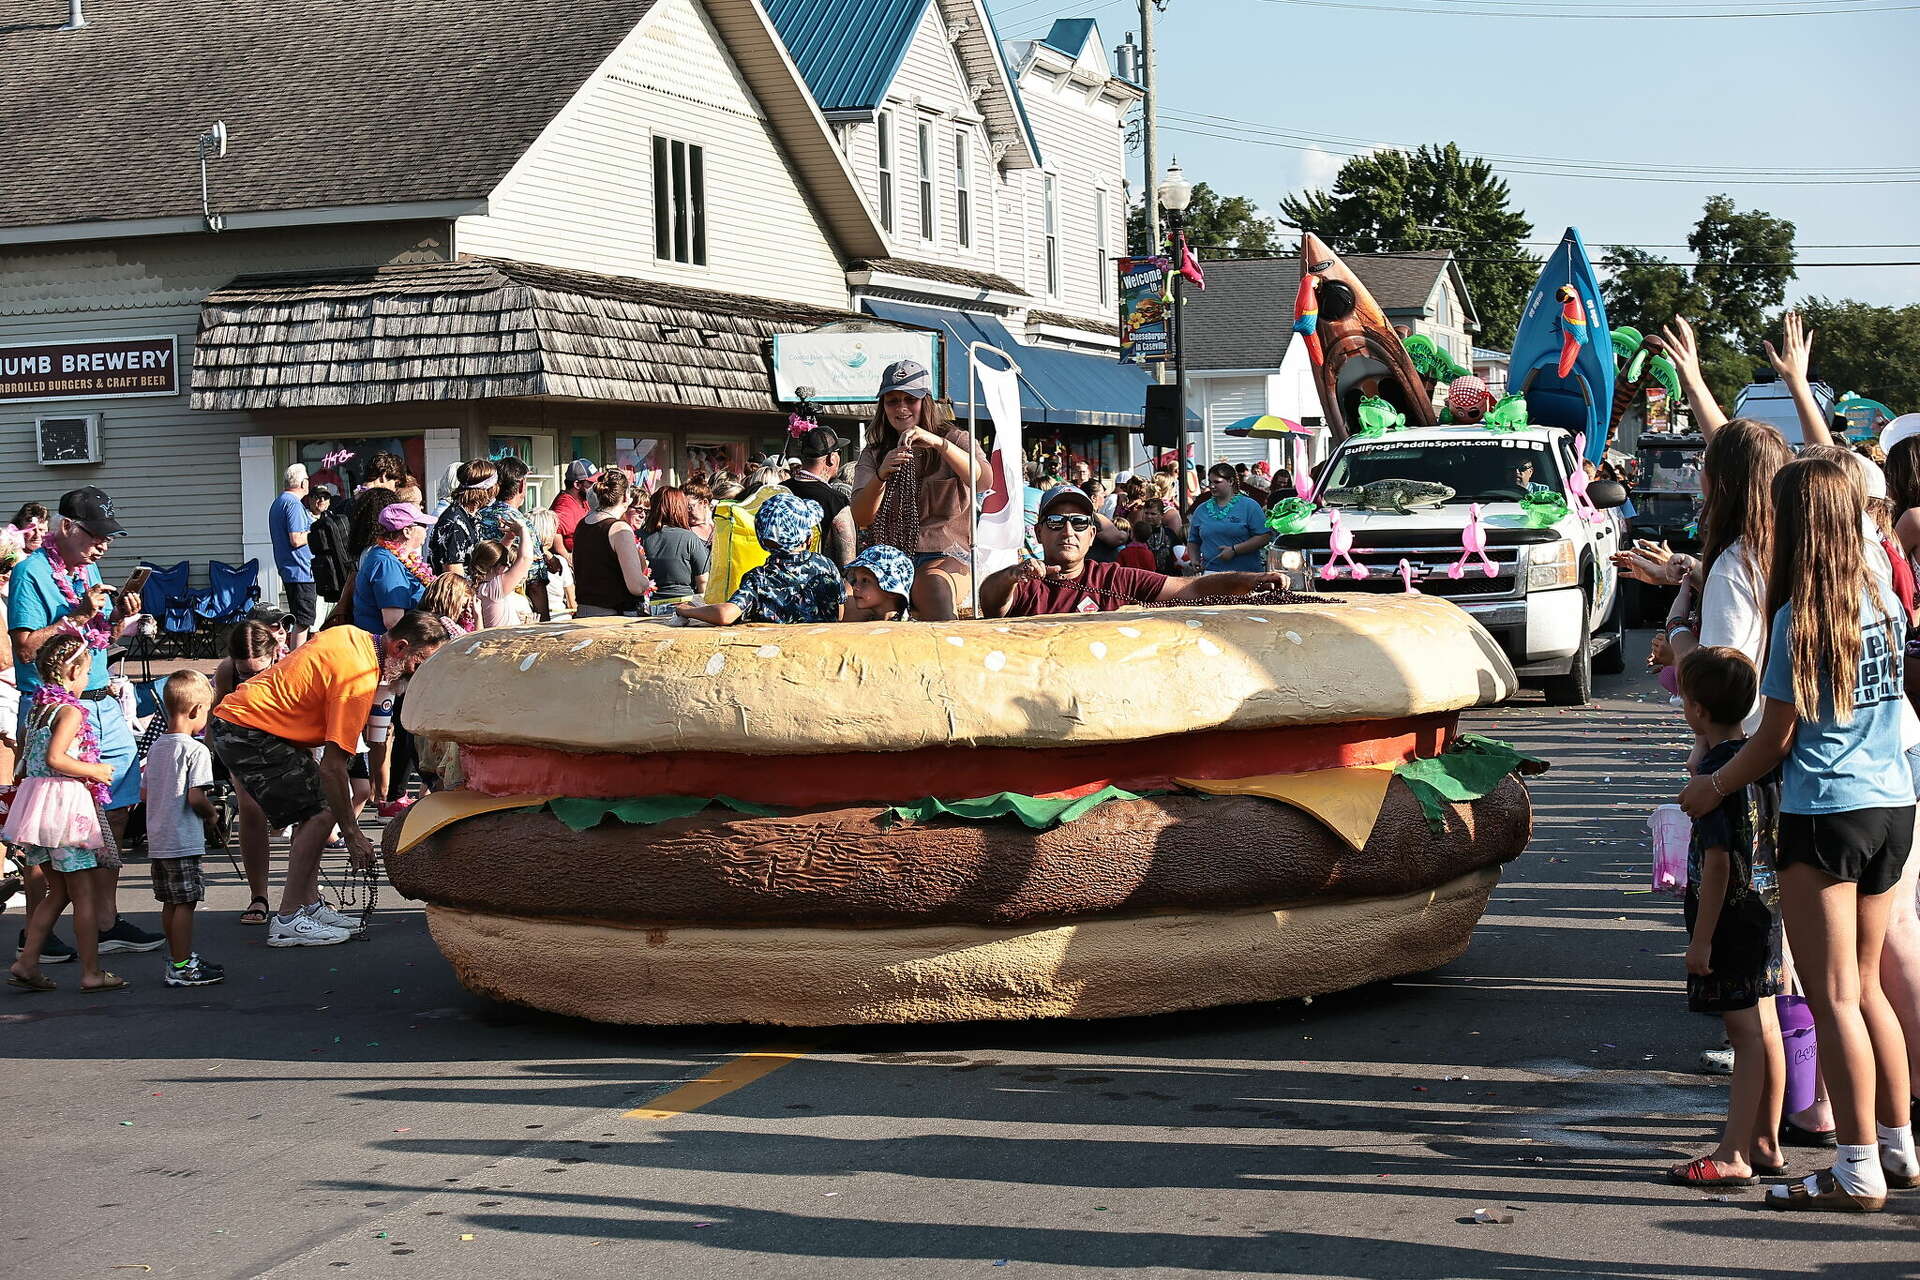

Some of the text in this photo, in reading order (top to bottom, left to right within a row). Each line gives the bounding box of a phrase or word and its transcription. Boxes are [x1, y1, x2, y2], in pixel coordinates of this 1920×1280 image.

[1123, 269, 1162, 289] Welcome
[1150, 283, 1158, 292] to
[1129, 332, 1167, 341] Cheeseburger
[0, 350, 170, 375] UMB BREWERY
[48, 379, 93, 391] BURGERS
[96, 378, 103, 389] &
[107, 376, 138, 388] CRAFT
[140, 375, 166, 387] BEER
[1345, 439, 1498, 456] BullFrogsPaddleSports.com
